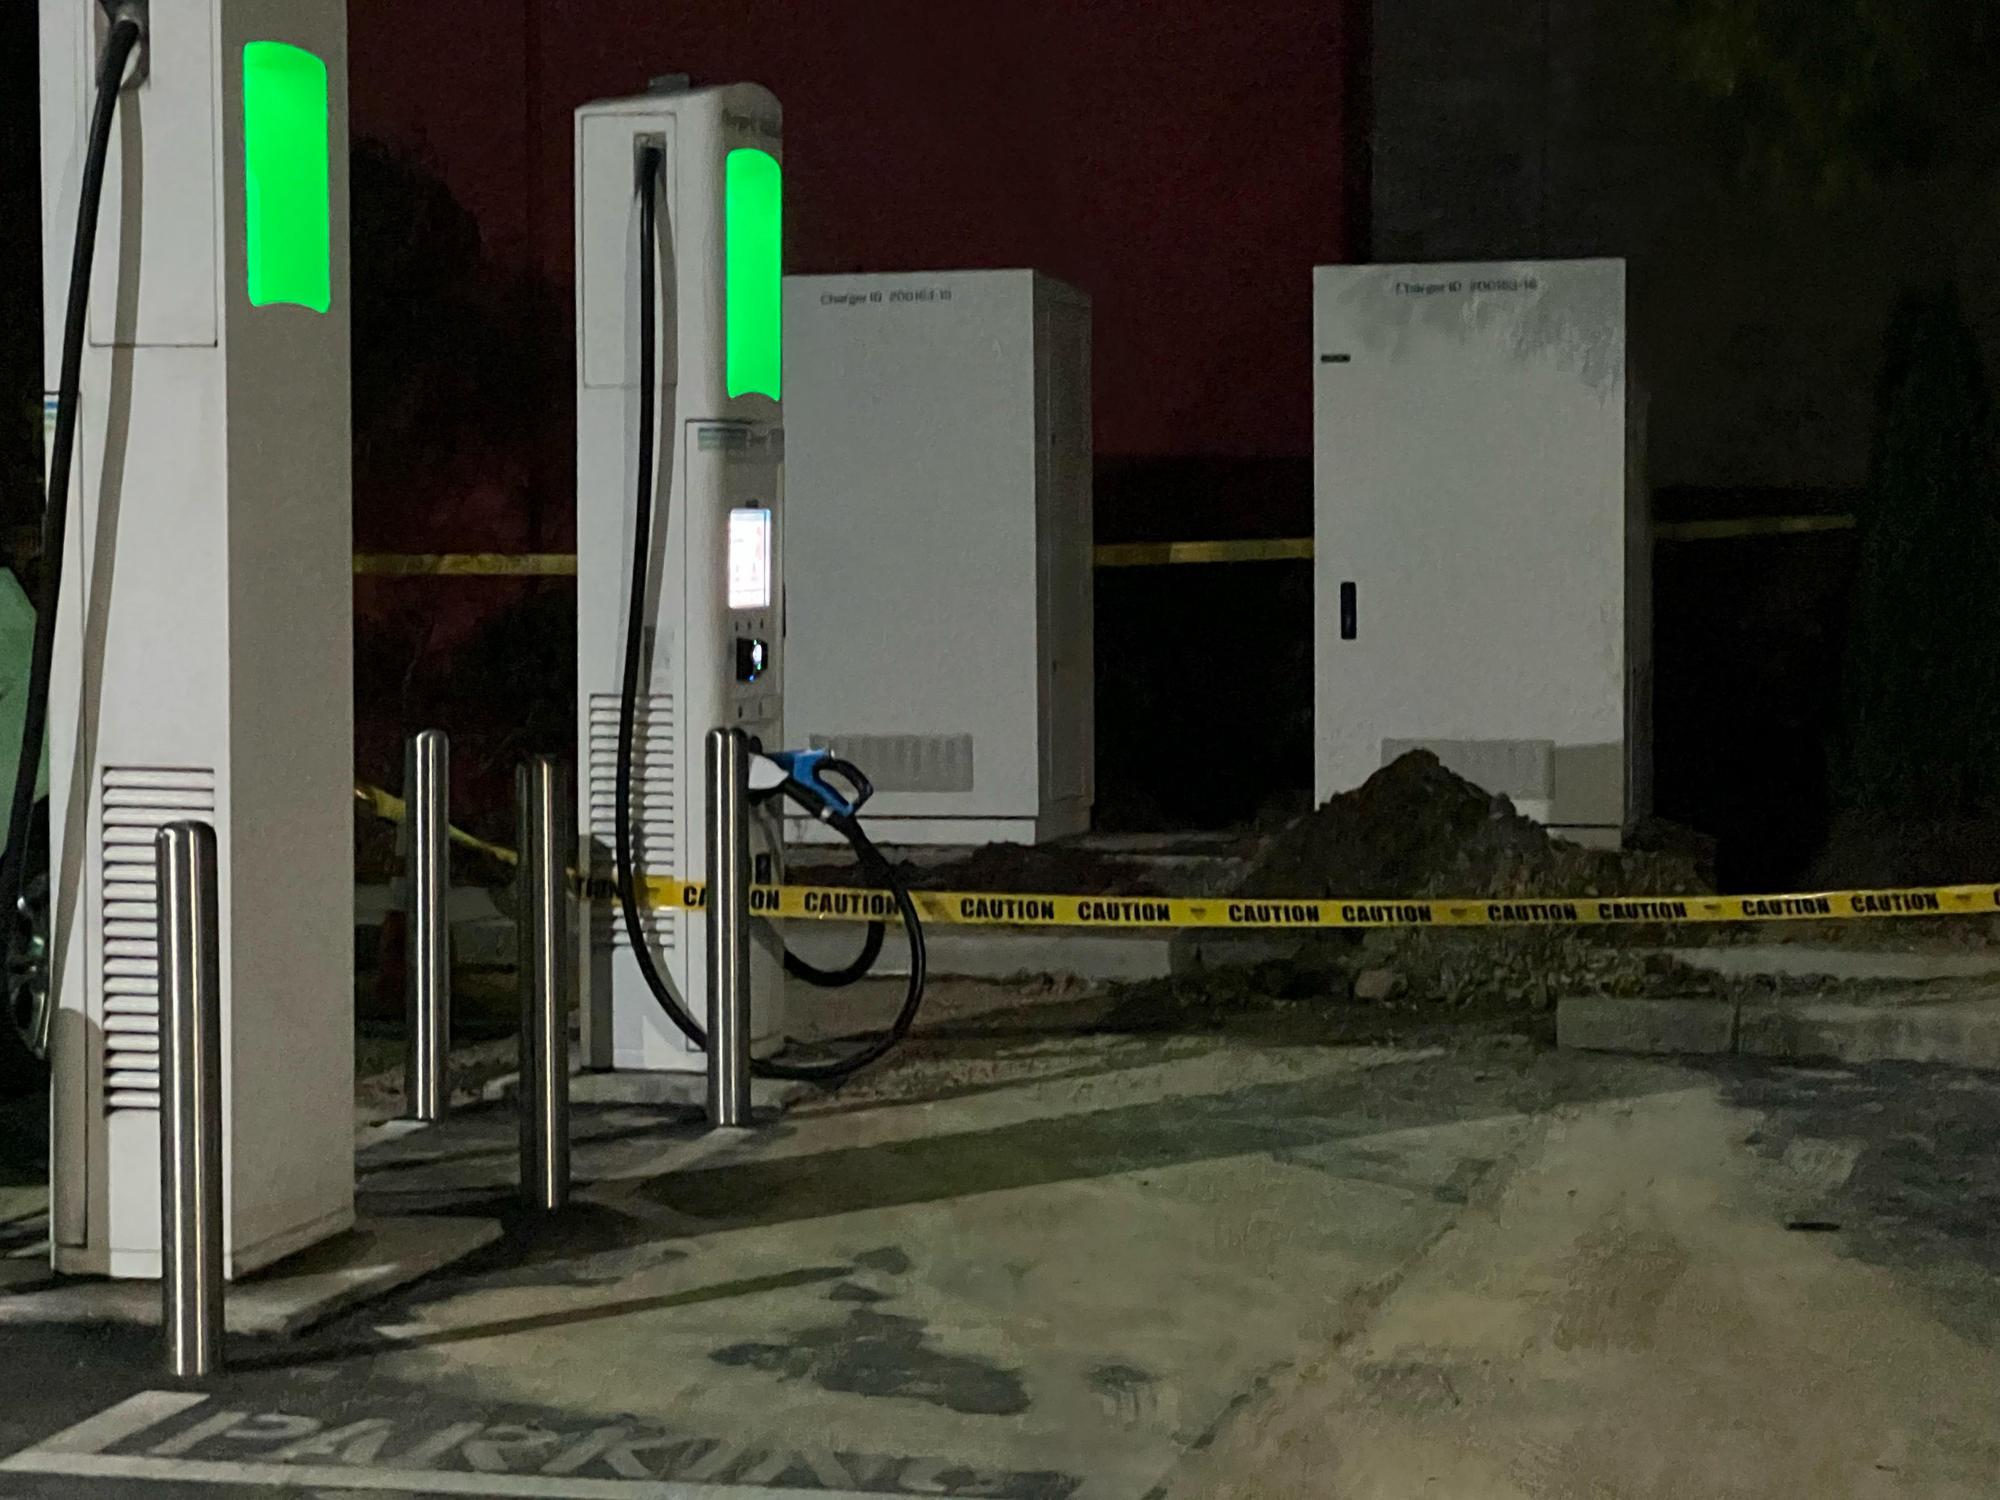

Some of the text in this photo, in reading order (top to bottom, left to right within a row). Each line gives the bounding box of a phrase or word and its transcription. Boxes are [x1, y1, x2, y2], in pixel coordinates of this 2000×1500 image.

[804, 892, 900, 916] CAUTION
[961, 898, 1055, 919] CAUTION
[1078, 901, 1171, 921] CAUTION
[1228, 904, 1320, 922] CAUTION
[1342, 905, 1432, 922] CAUTION
[1487, 904, 1578, 921] CAUTION
[1598, 902, 1688, 920] CAUTION
[1742, 898, 1831, 916] CAUTION
[1850, 893, 1940, 913] CAUTION
